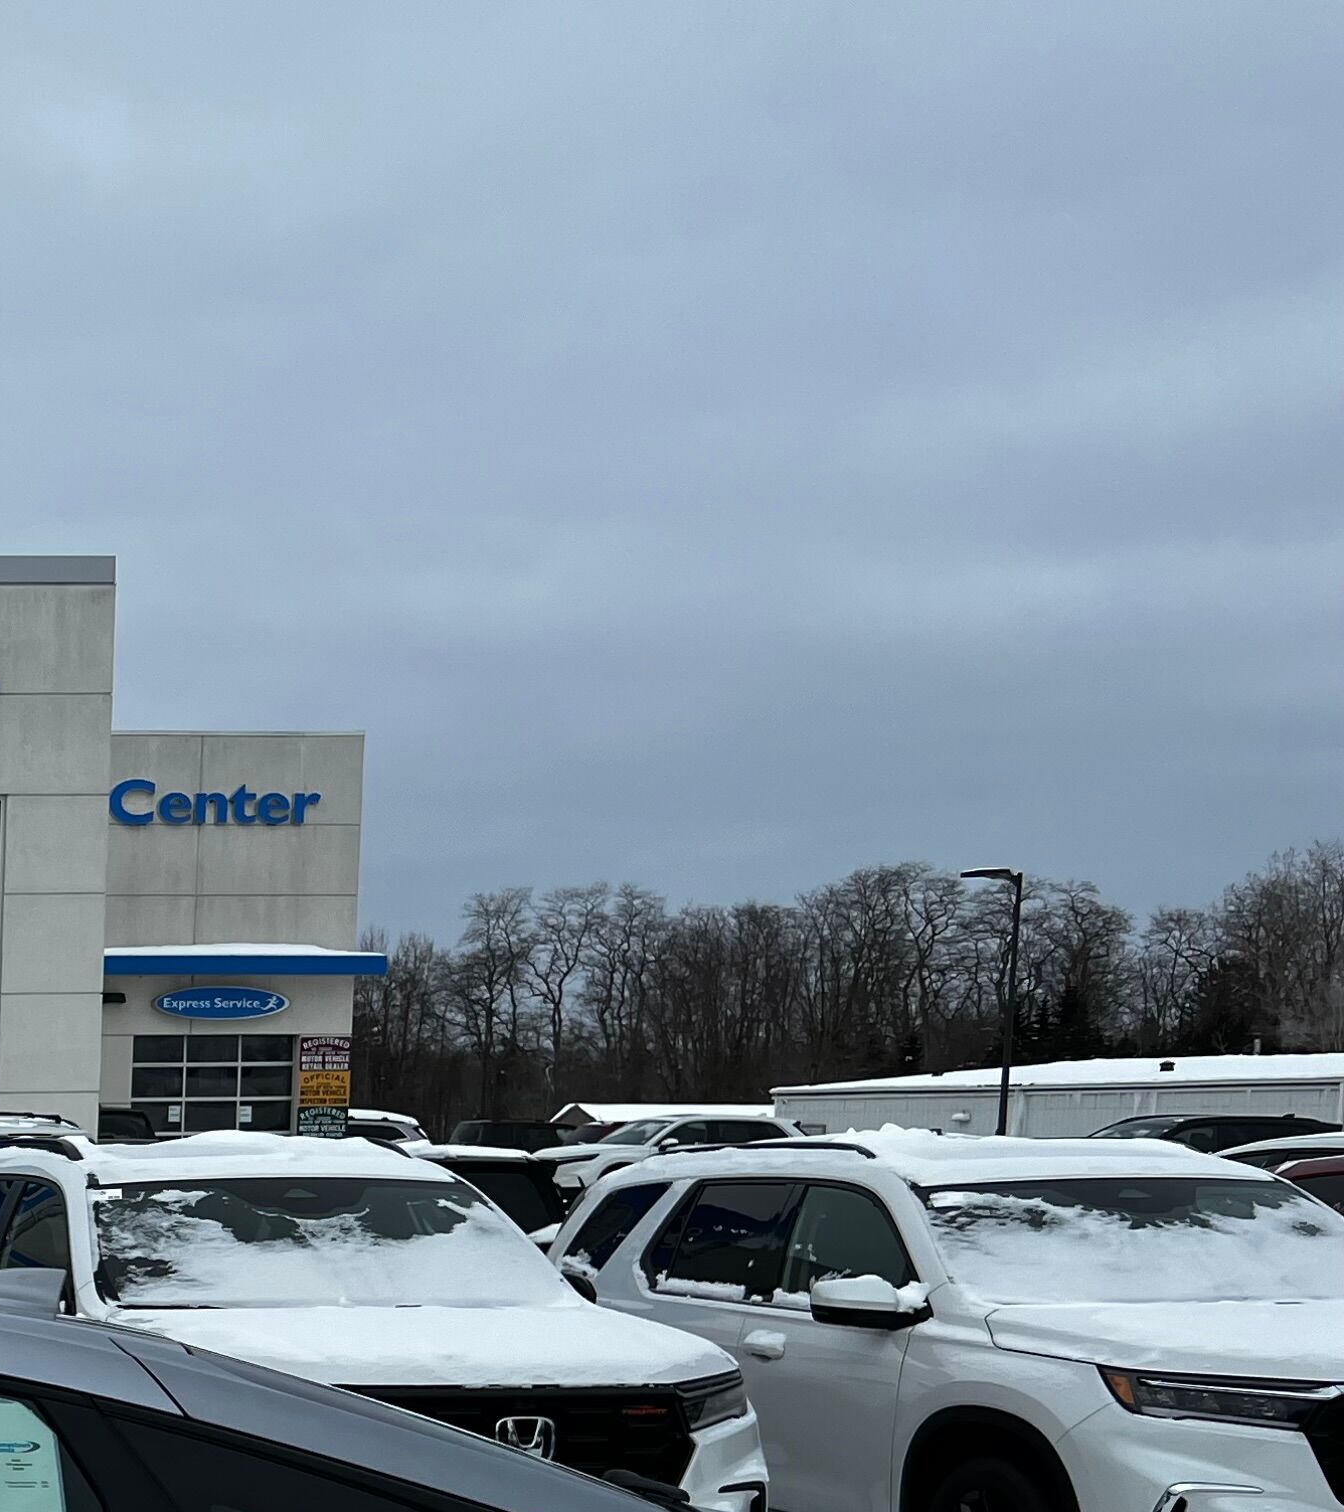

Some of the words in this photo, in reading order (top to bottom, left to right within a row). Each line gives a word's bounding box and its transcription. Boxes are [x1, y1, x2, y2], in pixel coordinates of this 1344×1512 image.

[109, 778, 322, 826] Center
[163, 998, 211, 1011] Express
[214, 998, 261, 1009] Service
[302, 1038, 350, 1050] REGISTERED
[303, 1072, 346, 1084] OFFICIAL
[299, 1107, 346, 1120] REGISTERED
